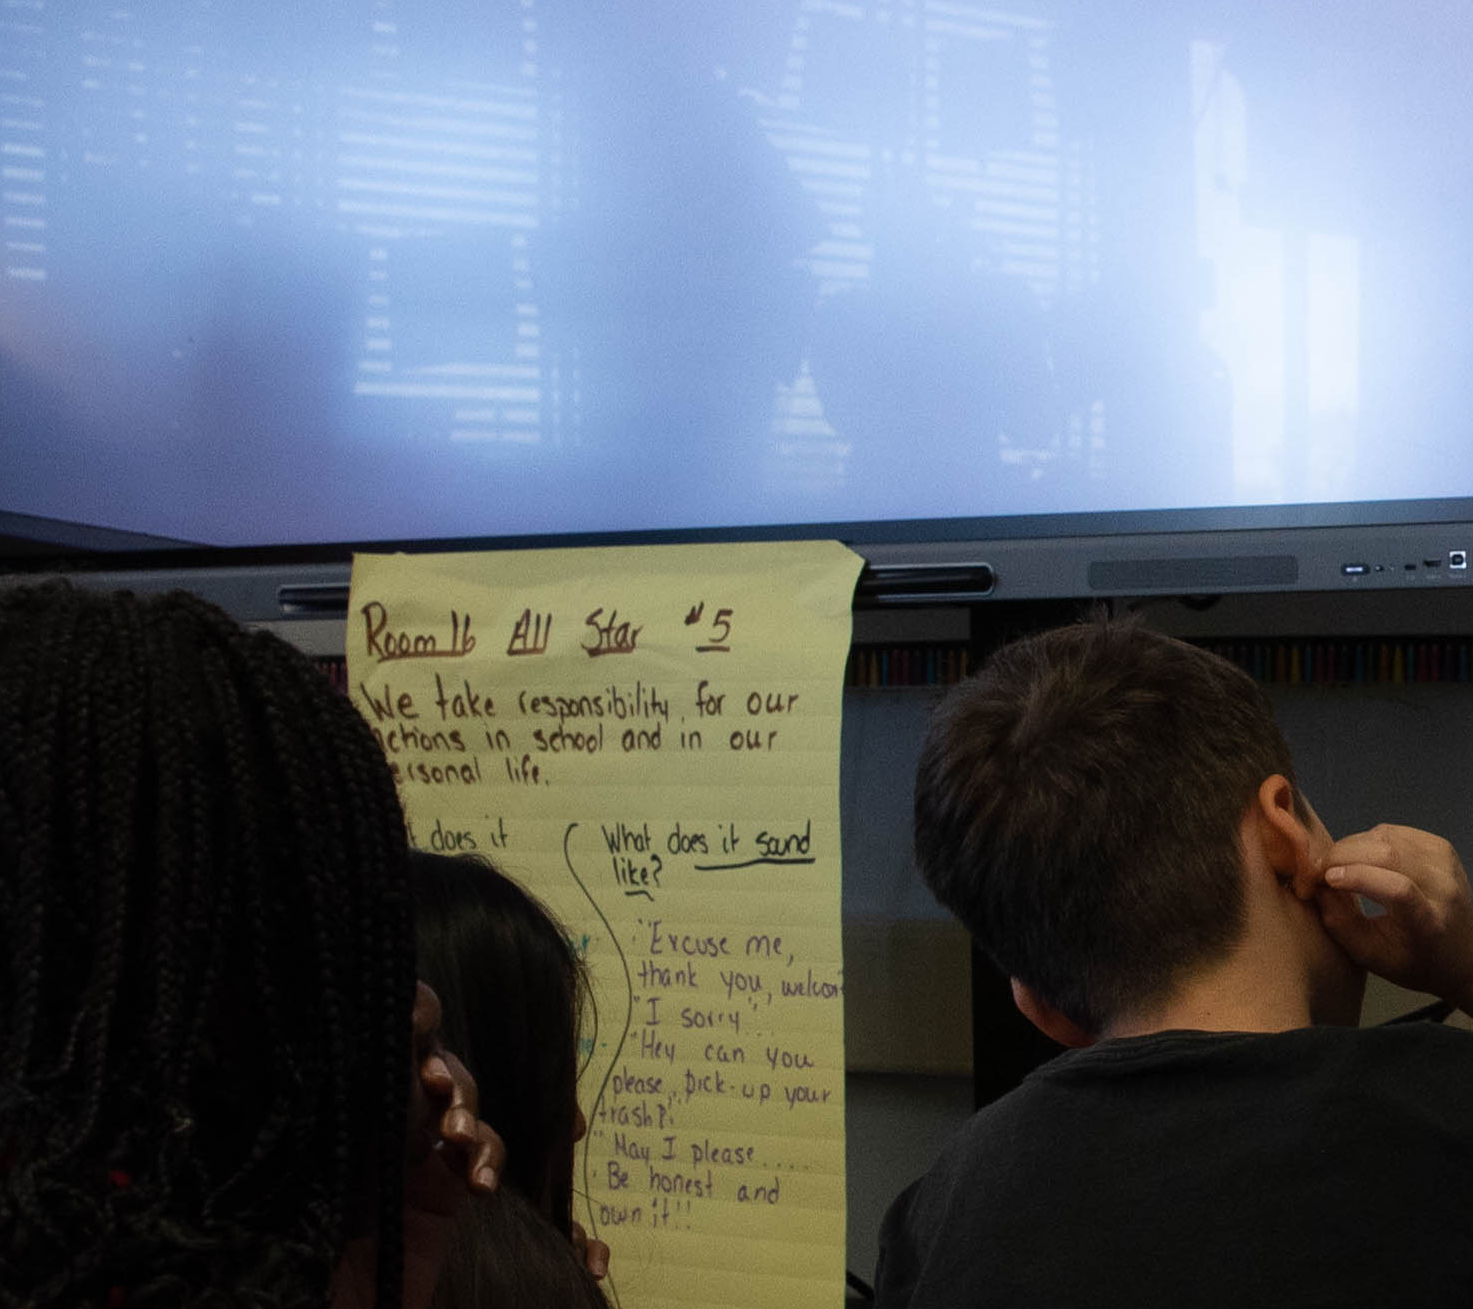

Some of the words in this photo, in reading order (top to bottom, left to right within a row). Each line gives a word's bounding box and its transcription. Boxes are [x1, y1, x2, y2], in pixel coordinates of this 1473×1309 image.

[361, 601, 437, 658] Room
[506, 608, 553, 656] All
[580, 607, 644, 655] Star
[360, 681, 420, 721] We
[435, 671, 497, 721] take
[519, 679, 670, 725] responsibility
[695, 679, 726, 718] for
[747, 691, 799, 716] our
[486, 728, 511, 752] in
[533, 723, 604, 754] school
[622, 721, 662, 753] and
[680, 719, 703, 750] in
[730, 729, 778, 752] our
[431, 819, 478, 851] does
[485, 815, 509, 849] it
[601, 821, 651, 856] What
[667, 822, 710, 855] does
[718, 822, 740, 853] it
[612, 852, 664, 888] like?
[637, 959, 699, 989] thank
[704, 1043, 745, 1064] can
[766, 1046, 815, 1071] you
[785, 1085, 832, 1110] your
[661, 1136, 677, 1161] I
[607, 1160, 628, 1191] Be
[649, 1164, 713, 1198] honest
[736, 1176, 780, 1205] and
[599, 1203, 643, 1227] own
